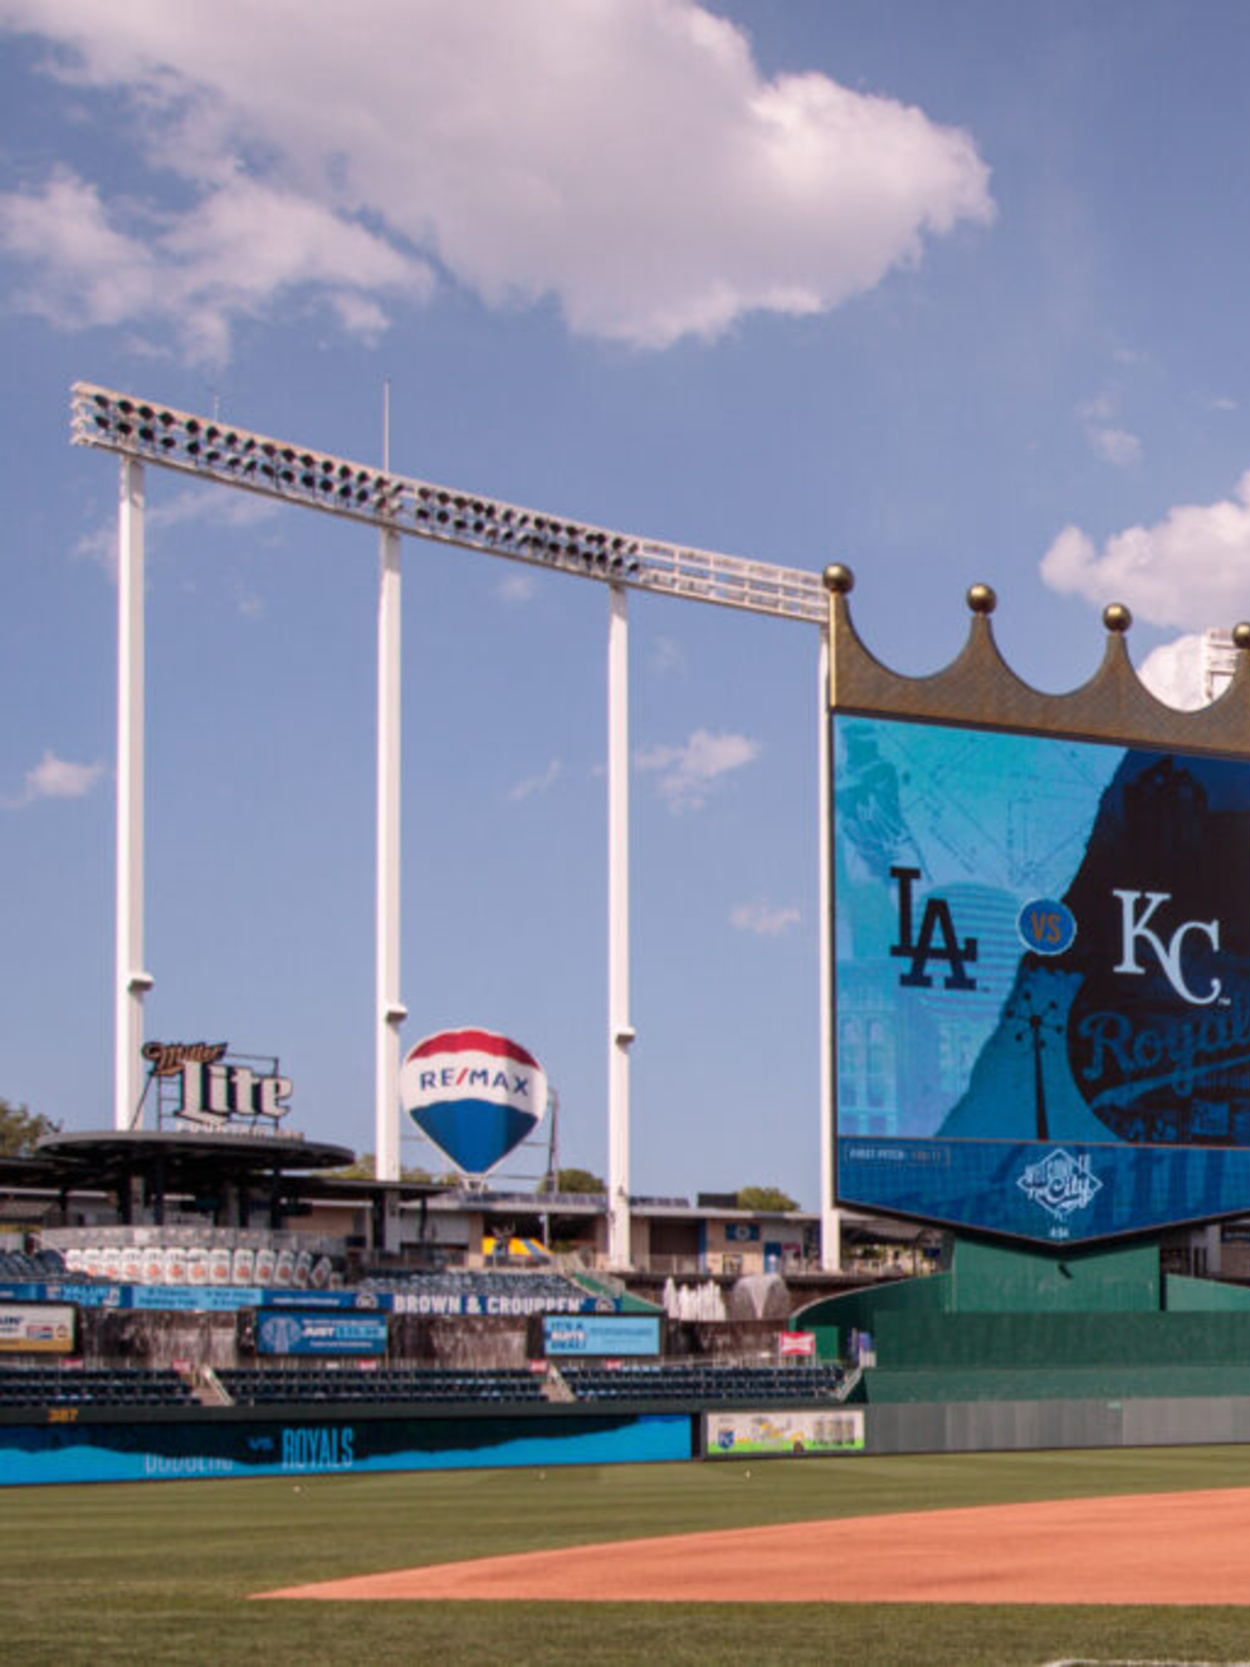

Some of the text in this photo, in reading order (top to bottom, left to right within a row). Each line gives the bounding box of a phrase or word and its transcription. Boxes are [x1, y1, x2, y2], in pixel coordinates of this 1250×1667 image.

[889, 866, 978, 992] LA
[1030, 911, 1061, 943] VS
[1112, 889, 1220, 1006] KC
[142, 1042, 228, 1076] Miller
[175, 1060, 293, 1124] Lite
[419, 1067, 528, 1097] RE/MAX
[392, 1295, 460, 1315] BROWN
[467, 1297, 481, 1315] &
[282, 1428, 354, 1468] ROYALS
